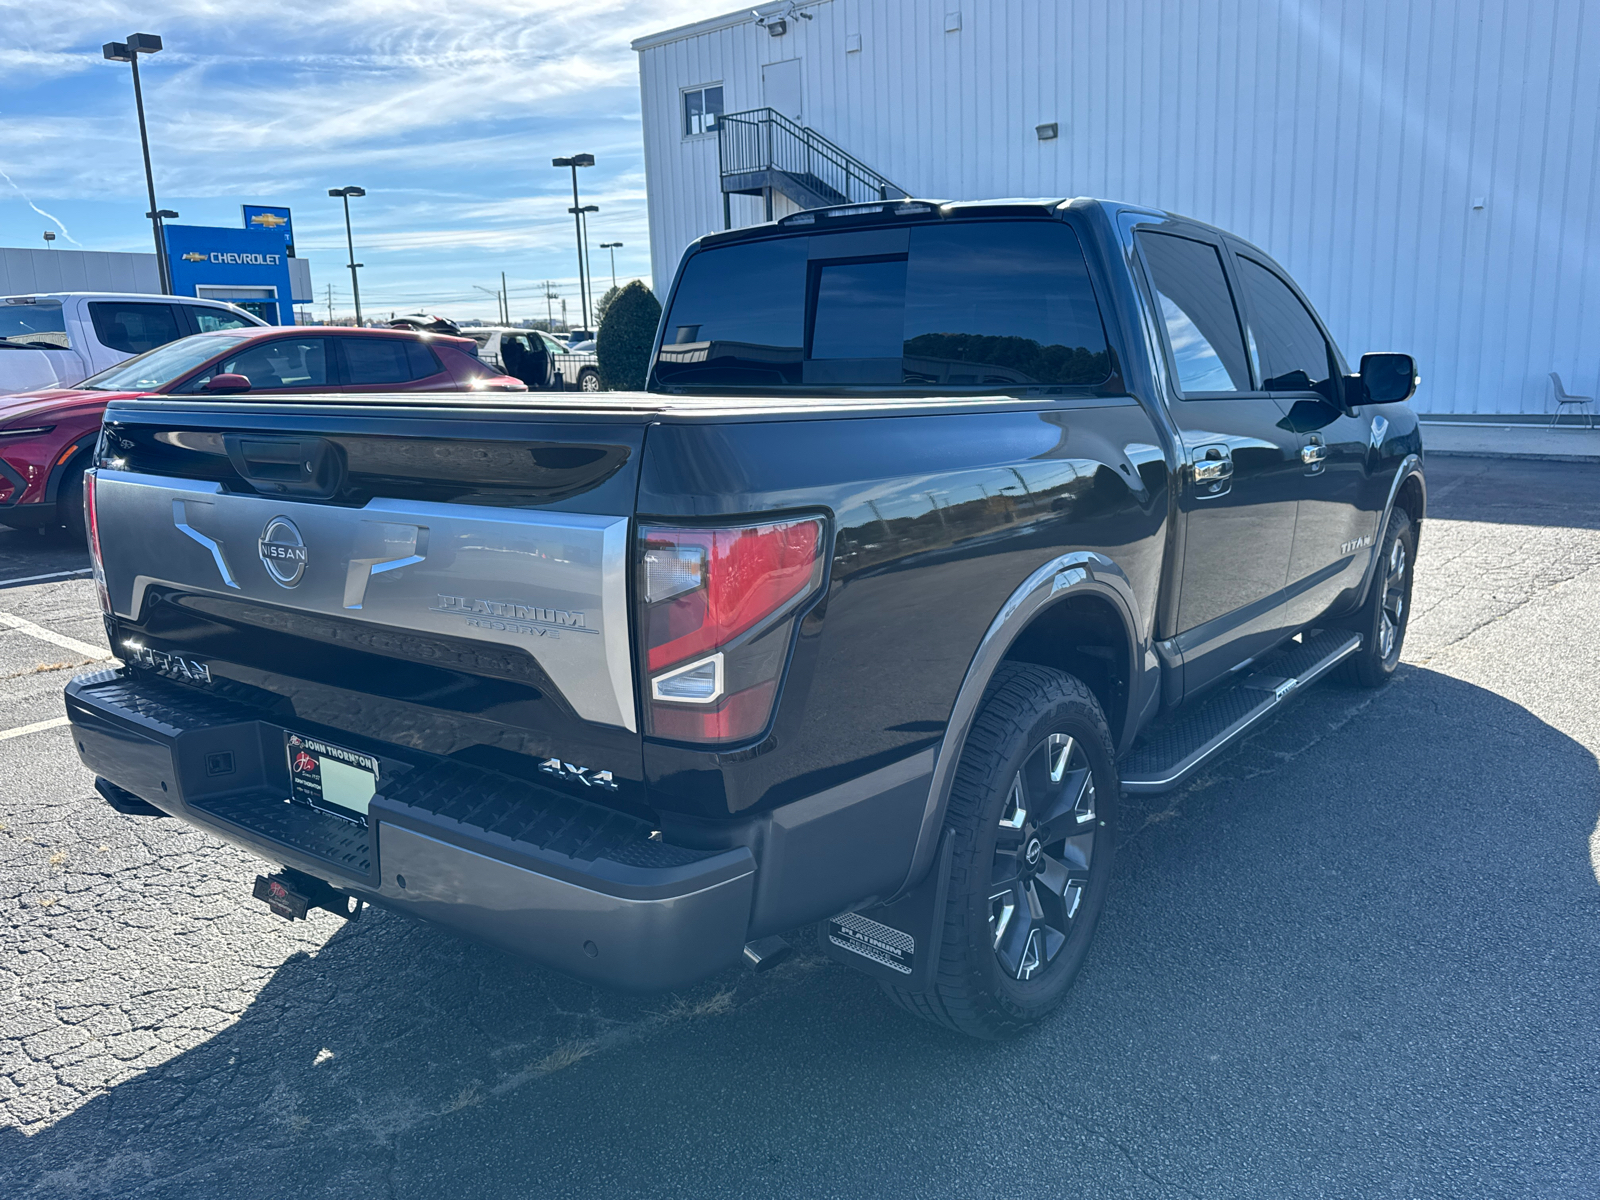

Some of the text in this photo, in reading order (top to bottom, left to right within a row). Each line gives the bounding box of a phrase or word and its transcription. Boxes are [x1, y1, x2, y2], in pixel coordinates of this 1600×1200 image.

[210, 252, 280, 265] CHEVROLET
[262, 544, 305, 560] NISSAN
[1341, 534, 1371, 555] TITAN
[437, 593, 586, 628] PLATINUM
[465, 617, 560, 640] RESERVE
[304, 739, 372, 769] JOHN THORNTON
[841, 926, 902, 955] PLATINUM
